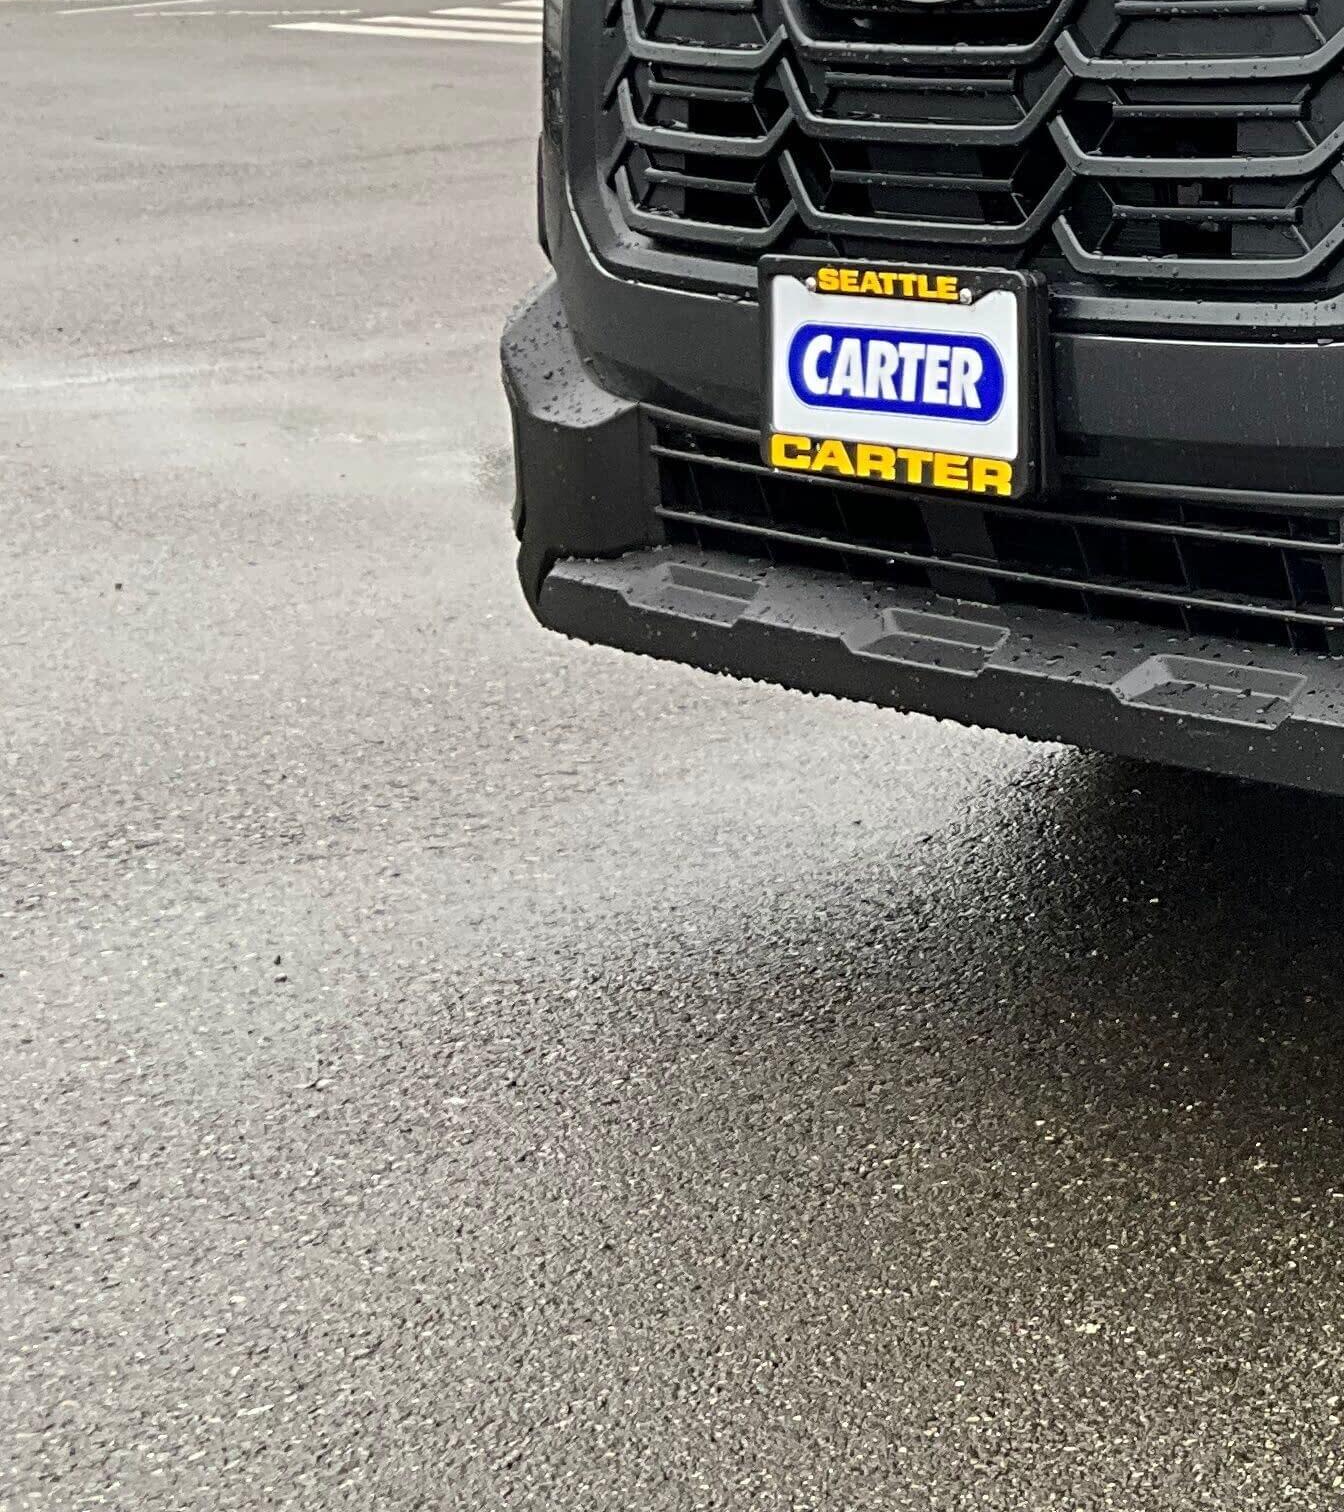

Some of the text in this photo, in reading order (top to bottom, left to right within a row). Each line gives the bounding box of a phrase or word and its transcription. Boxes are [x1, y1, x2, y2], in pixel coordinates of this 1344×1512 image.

[816, 267, 960, 302] SEATTLE
[802, 334, 985, 410] CARTER
[769, 433, 1014, 497] CARTER
